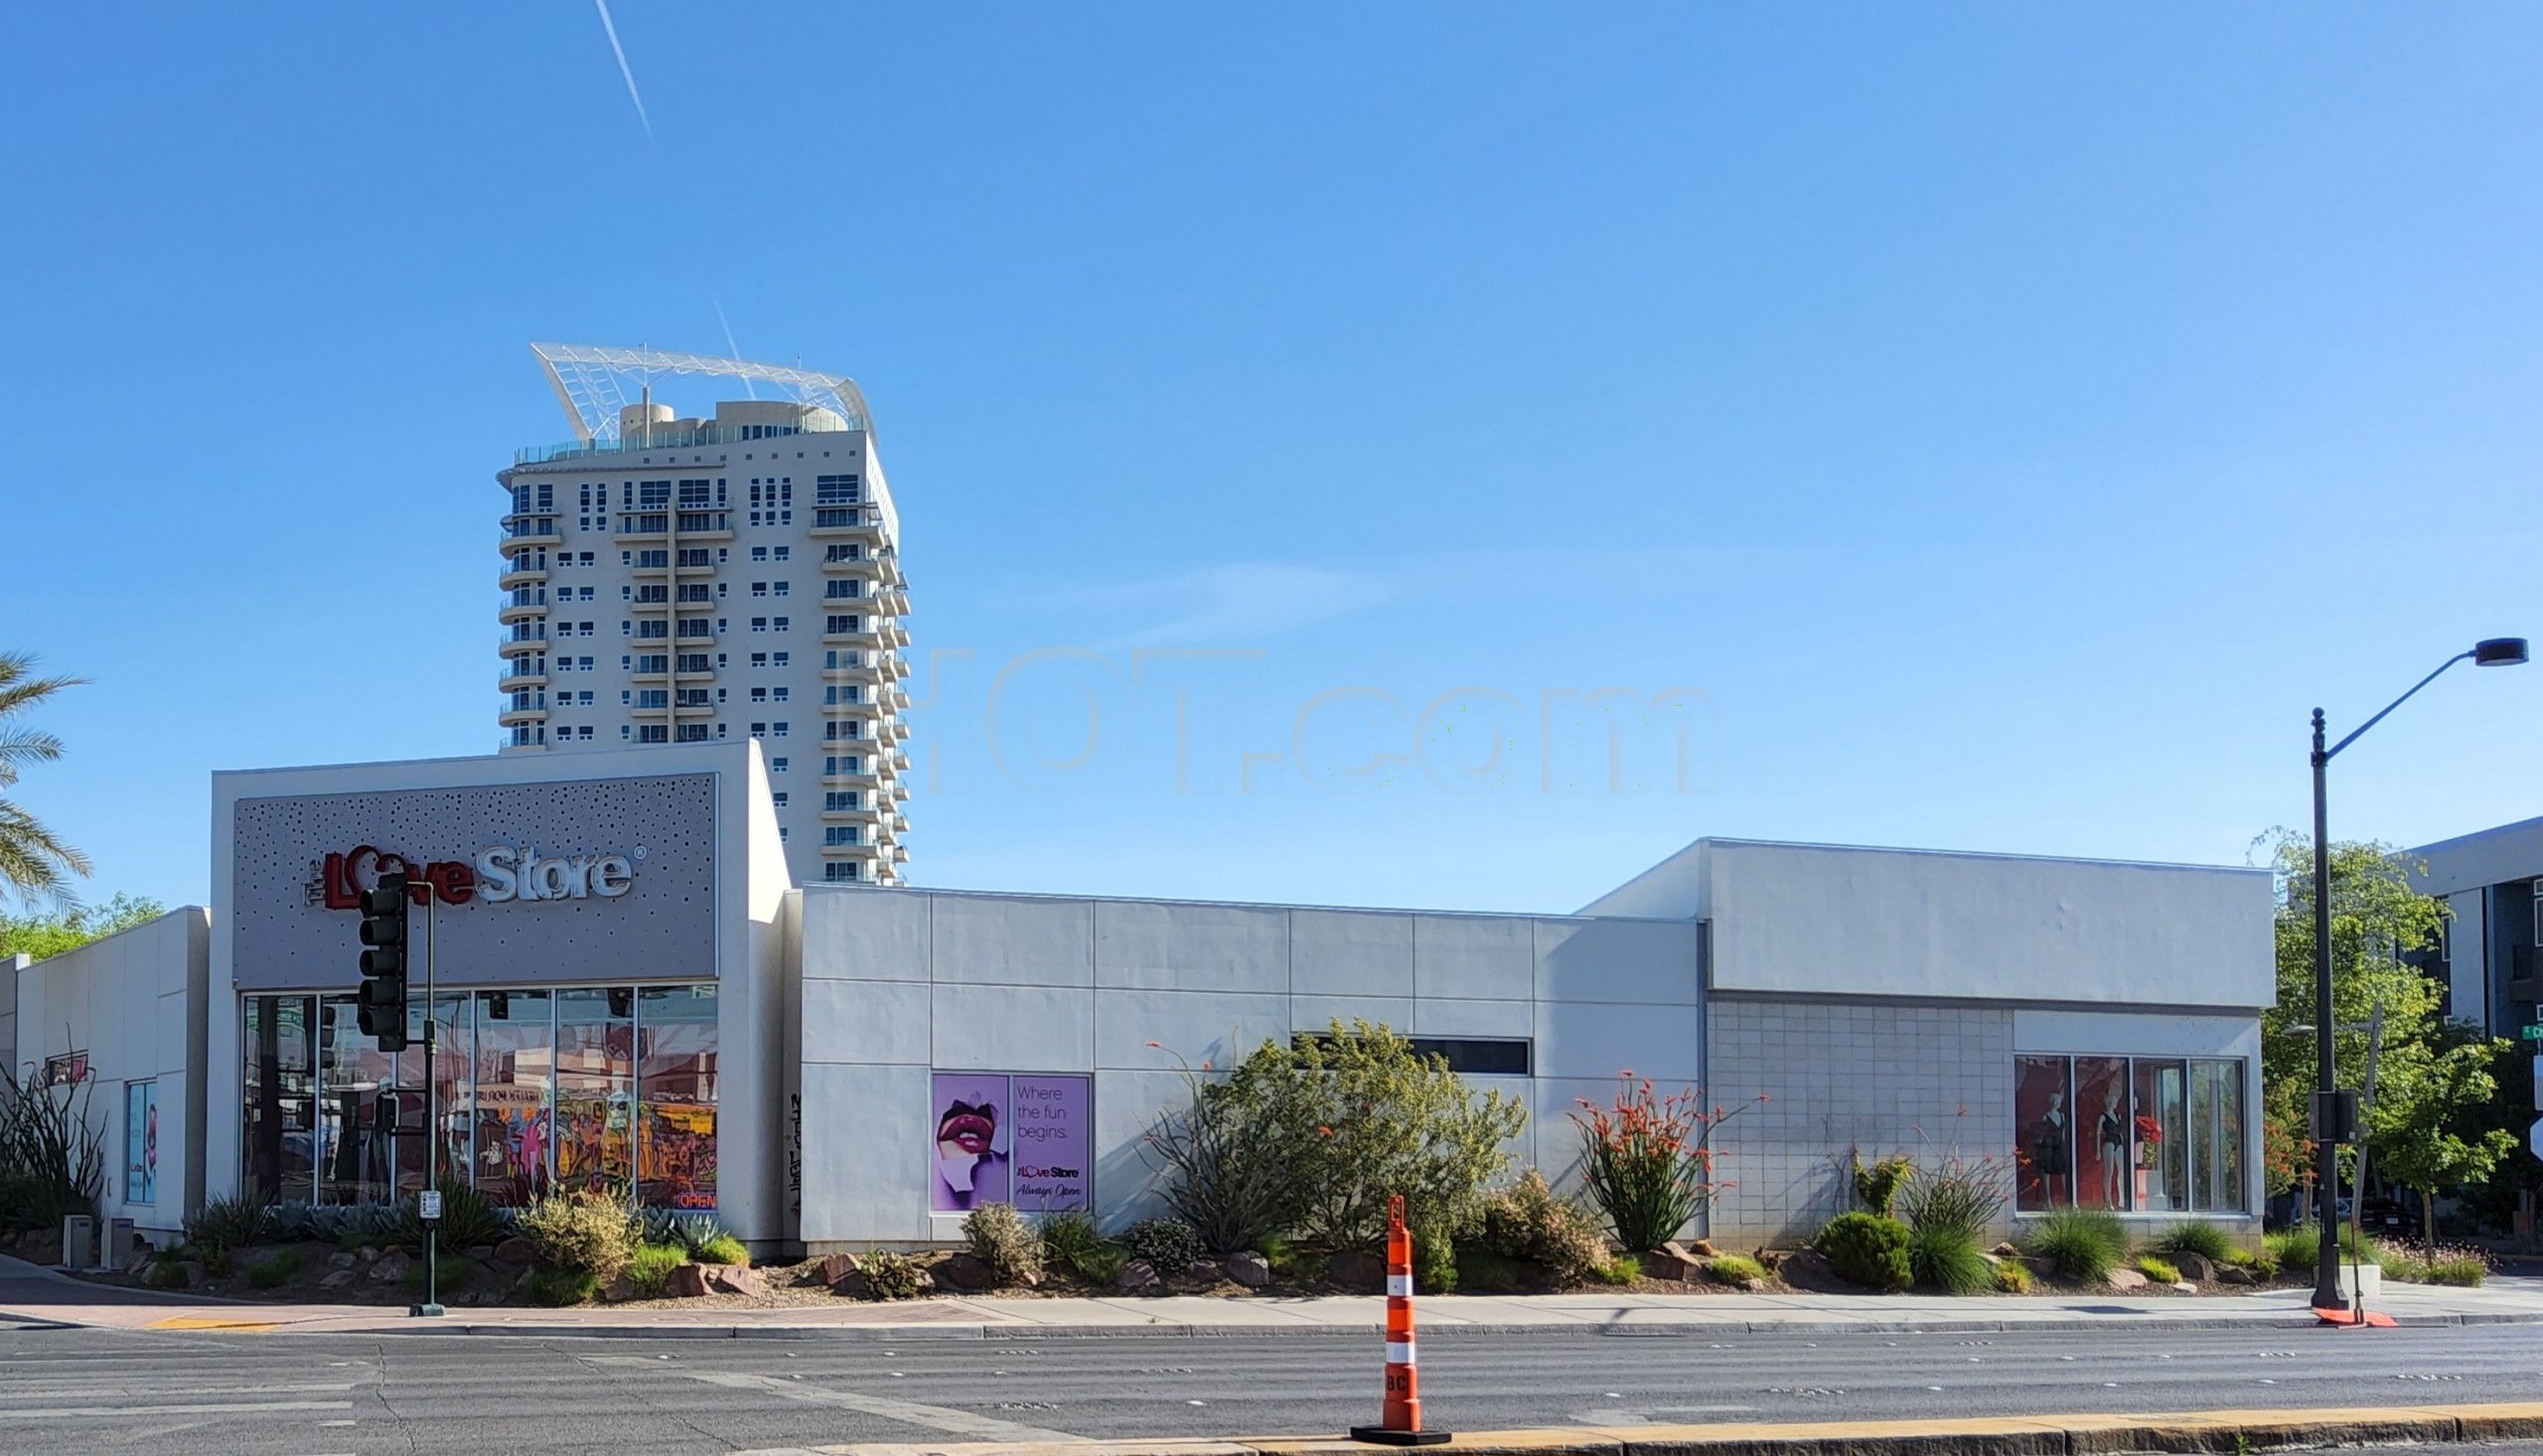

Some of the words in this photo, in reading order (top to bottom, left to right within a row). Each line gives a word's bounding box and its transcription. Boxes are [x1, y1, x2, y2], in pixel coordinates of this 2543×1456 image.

[1017, 1086, 1063, 1100] Where
[1017, 1104, 1040, 1119] the
[1044, 1104, 1066, 1119] fun
[1017, 1123, 1068, 1142] begins.
[1051, 1166, 1079, 1178] Store
[1015, 1184, 1053, 1199] Always
[1055, 1184, 1081, 1199] Open
[680, 1194, 716, 1209] OPEN
